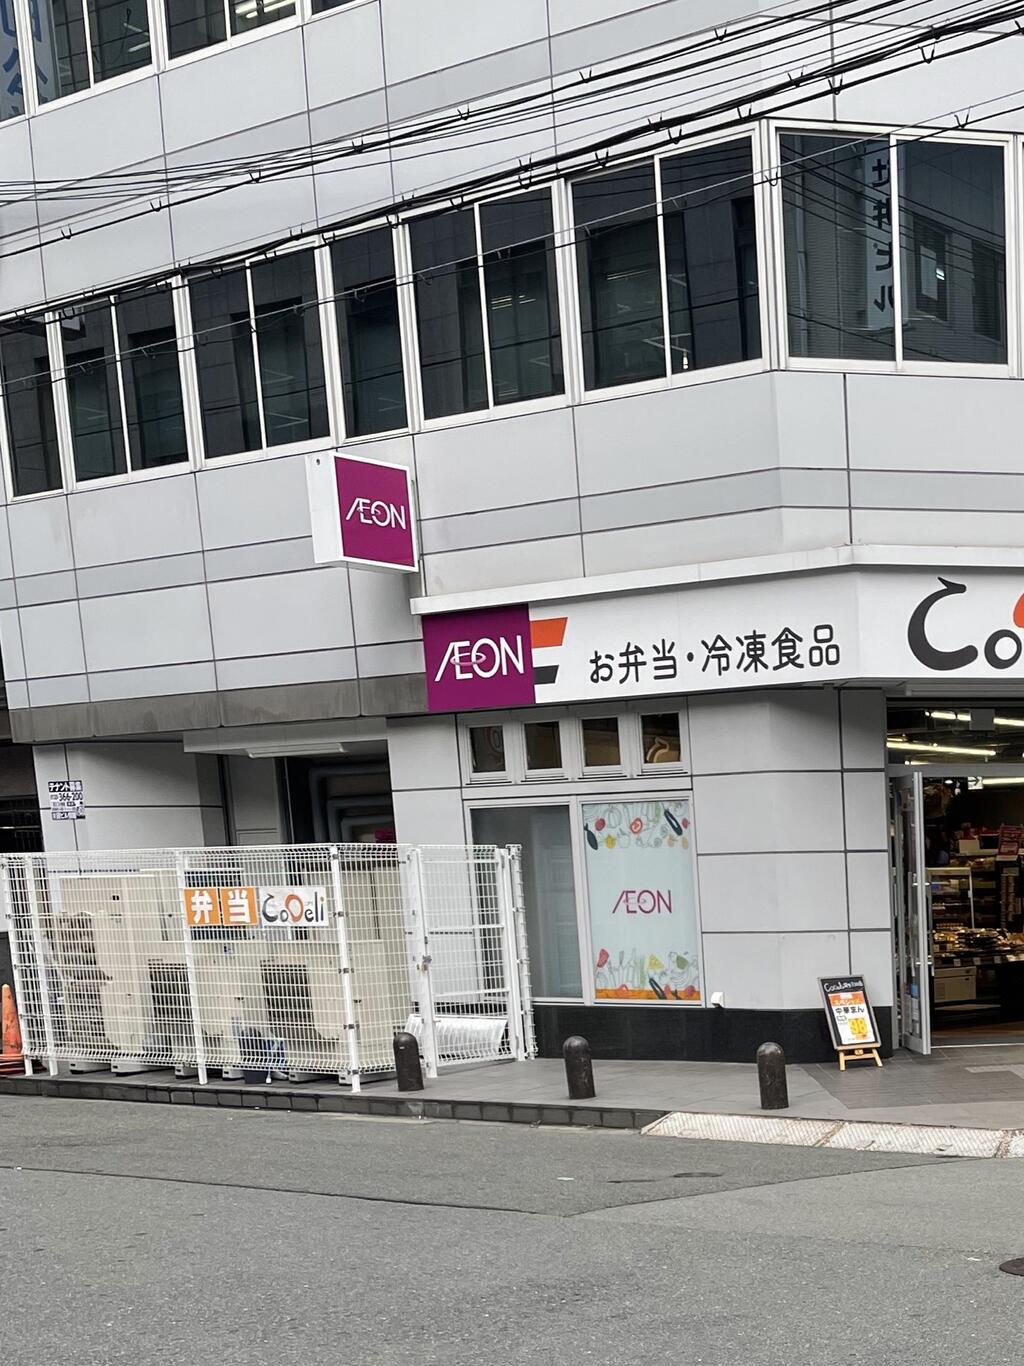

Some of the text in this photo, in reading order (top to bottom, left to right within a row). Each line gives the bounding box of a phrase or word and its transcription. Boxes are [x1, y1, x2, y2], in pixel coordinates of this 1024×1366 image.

[589, 623, 841, 684] お弁当・冷凍食品
[191, 889, 251, 924] 弁当
